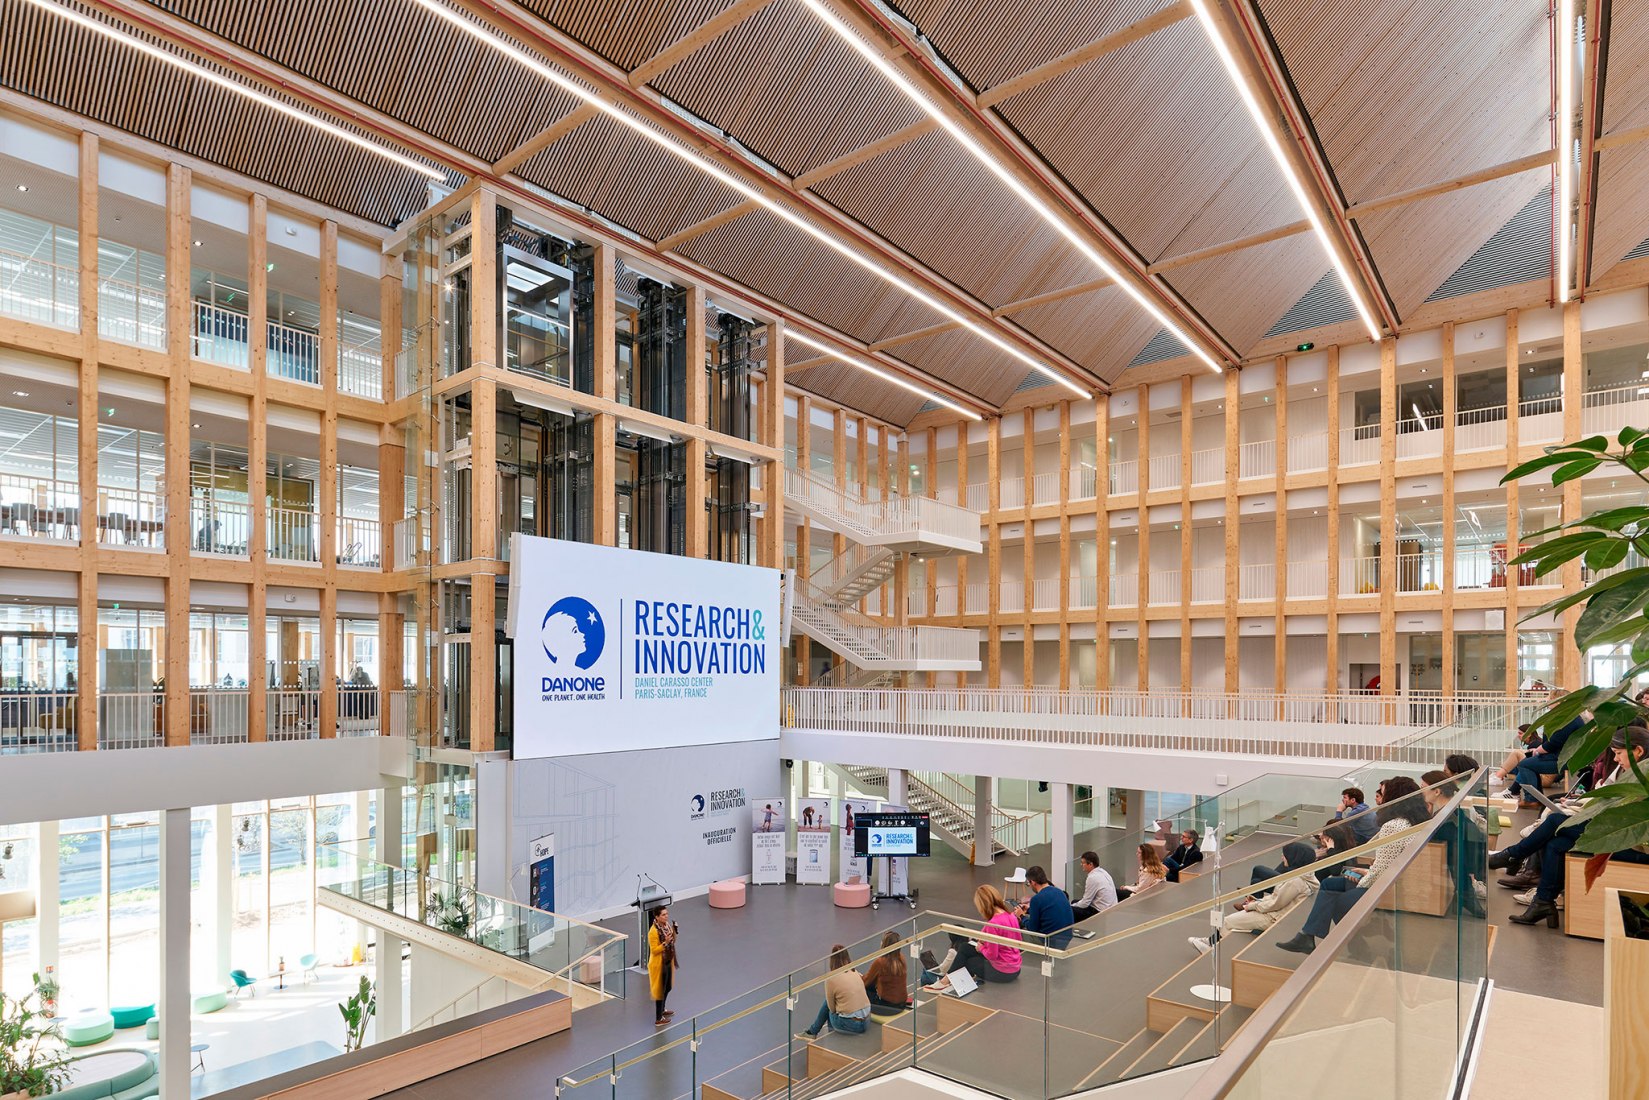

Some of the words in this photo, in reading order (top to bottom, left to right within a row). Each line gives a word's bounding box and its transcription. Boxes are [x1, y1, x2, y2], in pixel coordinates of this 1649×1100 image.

[635, 600, 765, 640] RESEARCH&
[635, 639, 765, 674] INNOVATION
[635, 677, 658, 687] DANIEL
[660, 677, 690, 687] CARASSO
[691, 677, 713, 687] CENTER
[576, 693, 586, 701] ONE
[635, 688, 683, 699] PARIS-SACLAY,
[684, 687, 707, 698] FRANCE
[711, 797, 746, 811] INNOVATION
[703, 827, 736, 839] INAUGURATION
[707, 835, 732, 845] OFFICIELLE
[540, 847, 549, 857] HOPE
